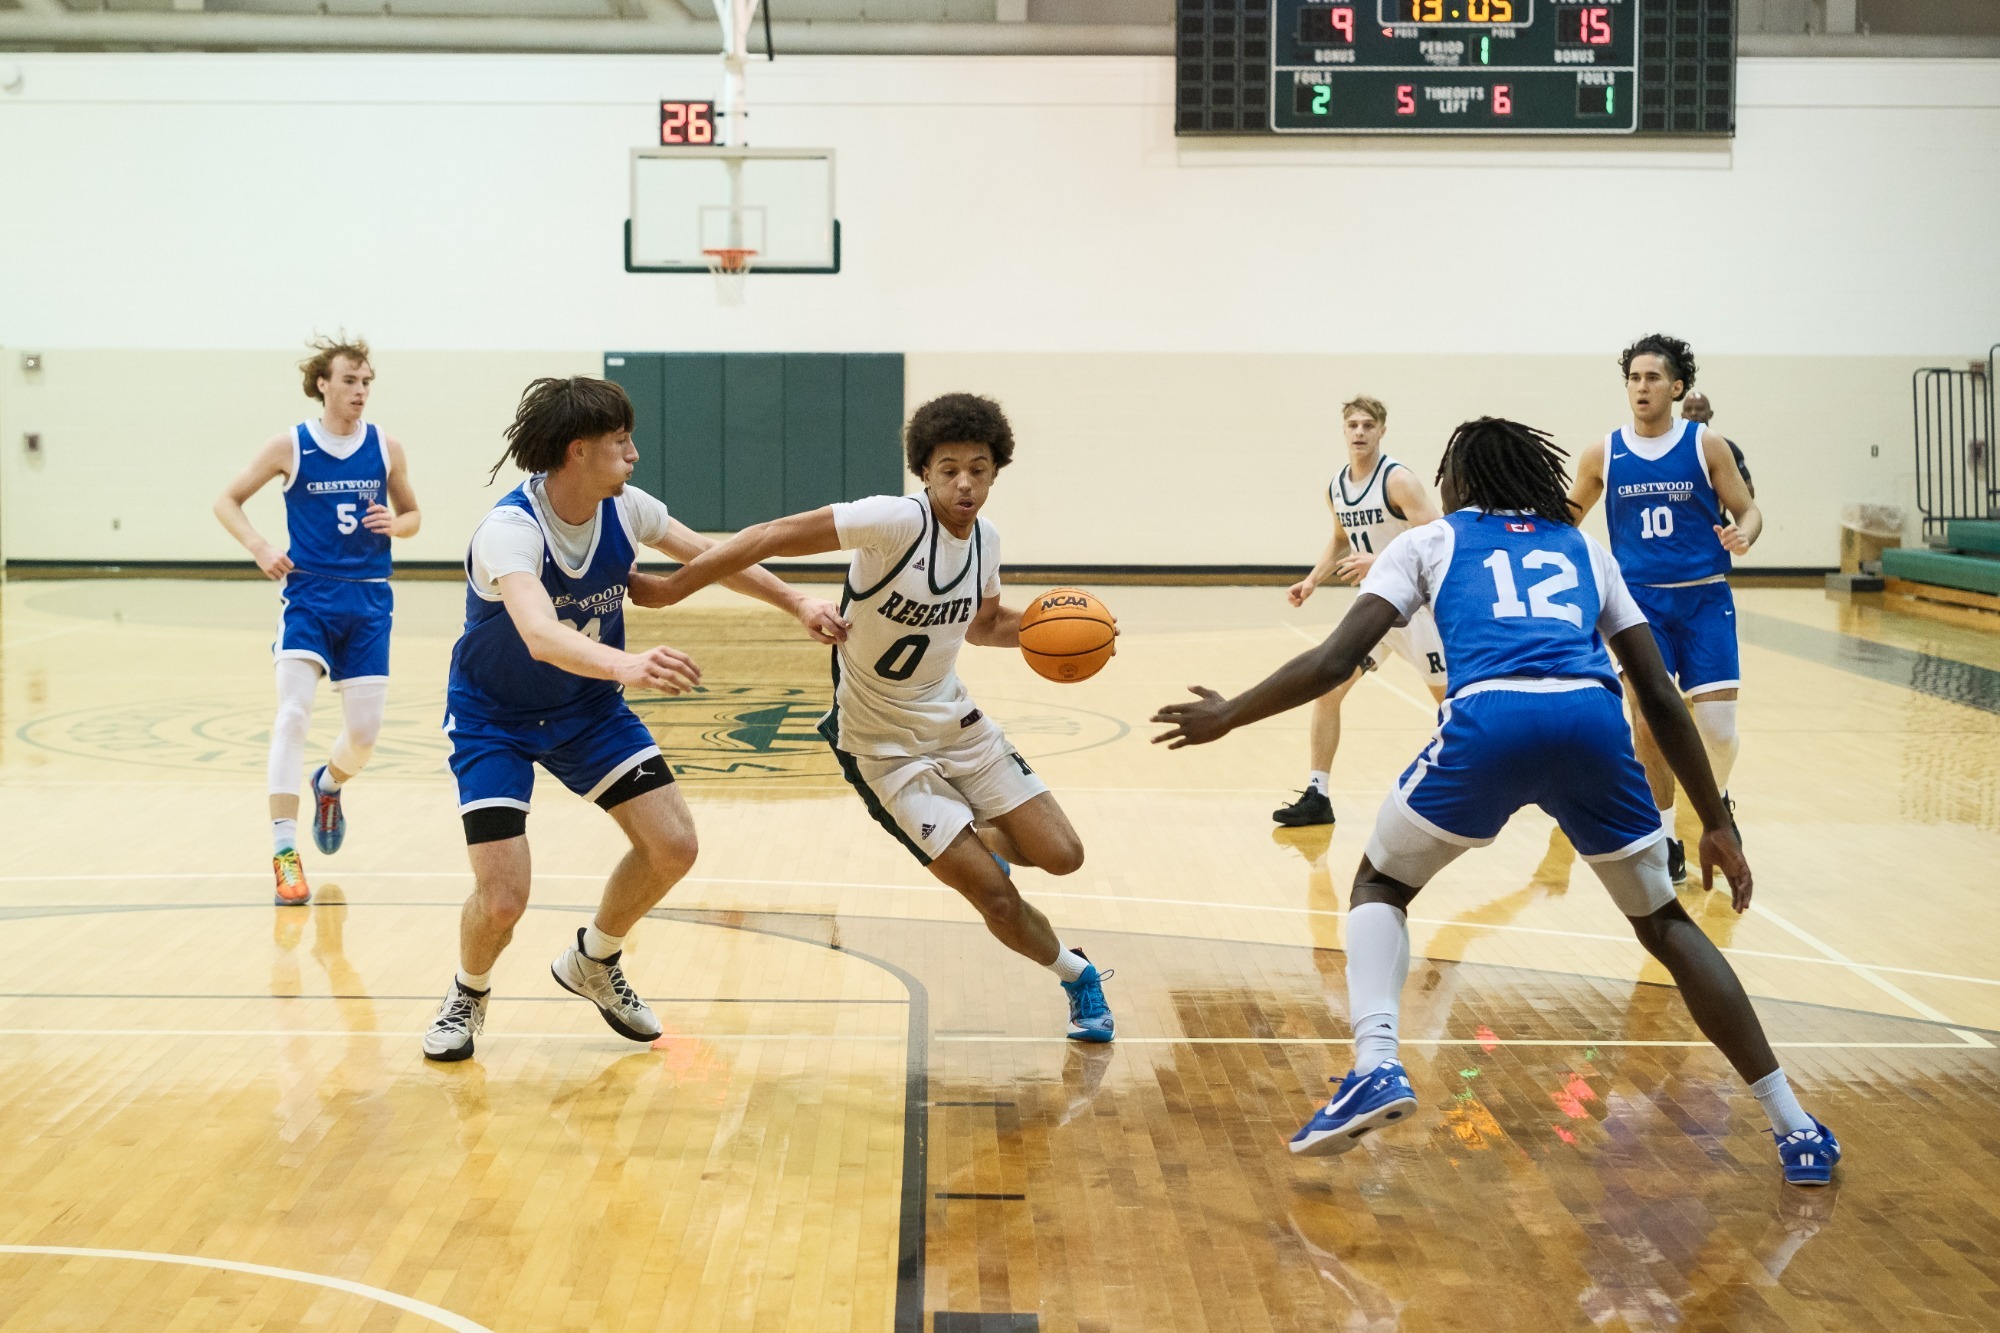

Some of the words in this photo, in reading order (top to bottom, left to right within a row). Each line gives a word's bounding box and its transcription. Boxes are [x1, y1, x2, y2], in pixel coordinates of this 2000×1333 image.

[1332, 8, 1353, 43] 9
[1580, 8, 1611, 44] 15
[1481, 36, 1490, 65] 1
[1554, 49, 1595, 63] BONUS
[1294, 71, 1332, 85] FOULS
[1577, 71, 1615, 85] FOULS
[1312, 85, 1331, 115] 2
[1397, 85, 1415, 114] 5
[1424, 86, 1484, 101] TIMEOUTS
[1493, 85, 1511, 114] 6
[1606, 86, 1614, 115] 1
[662, 103, 712, 143] 26
[307, 479, 380, 491] CRESTWOOD
[359, 492, 378, 501] PREP
[1618, 481, 1694, 495] CRESTWOOD
[1668, 493, 1691, 502] PREP
[336, 503, 358, 535] 5
[1640, 506, 1674, 539] 10
[1350, 531, 1374, 554] 11
[1040, 596, 1088, 611] NCAA
[1482, 549, 1582, 629] 12
[594, 599, 622, 615] PREP
[877, 590, 972, 627] RESERVE
[873, 634, 931, 681] 0
[1426, 651, 1445, 674] R
